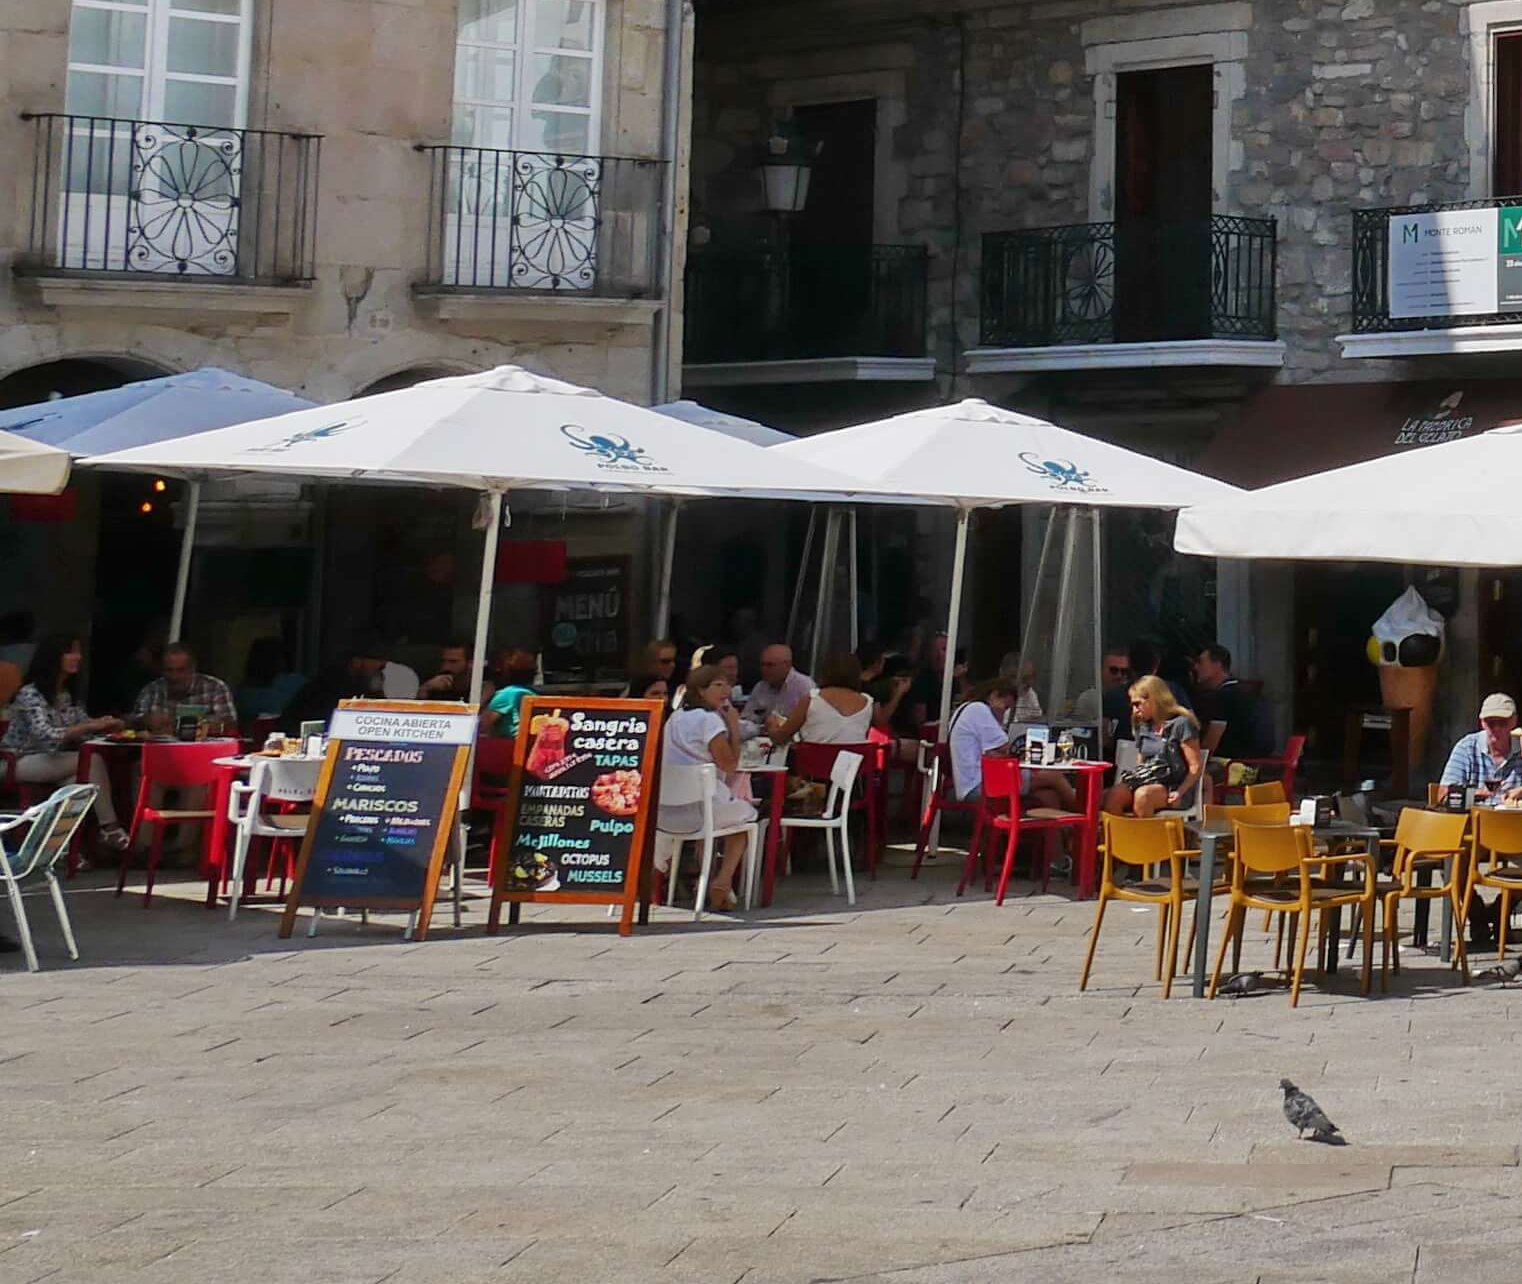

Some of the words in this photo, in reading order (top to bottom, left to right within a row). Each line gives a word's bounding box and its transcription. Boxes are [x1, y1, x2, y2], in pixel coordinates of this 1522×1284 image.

[1424, 228, 1452, 237] MONTE
[355, 715, 400, 727] COCINA
[402, 718, 452, 729] ABIERTA
[570, 711, 647, 735] Sangria
[358, 726, 390, 737] OPEN
[394, 728, 445, 739] KITCHEN
[573, 737, 640, 751] casera
[344, 747, 425, 764] PESCADOS
[594, 754, 639, 767] TAPAS
[332, 797, 420, 813] MARISCOS
[521, 803, 585, 817] EMPANADAS
[519, 816, 566, 828] CASERAS
[590, 819, 634, 836] Pulpo
[561, 853, 610, 865] OCTOPUS
[567, 870, 623, 884] MUSSELS
